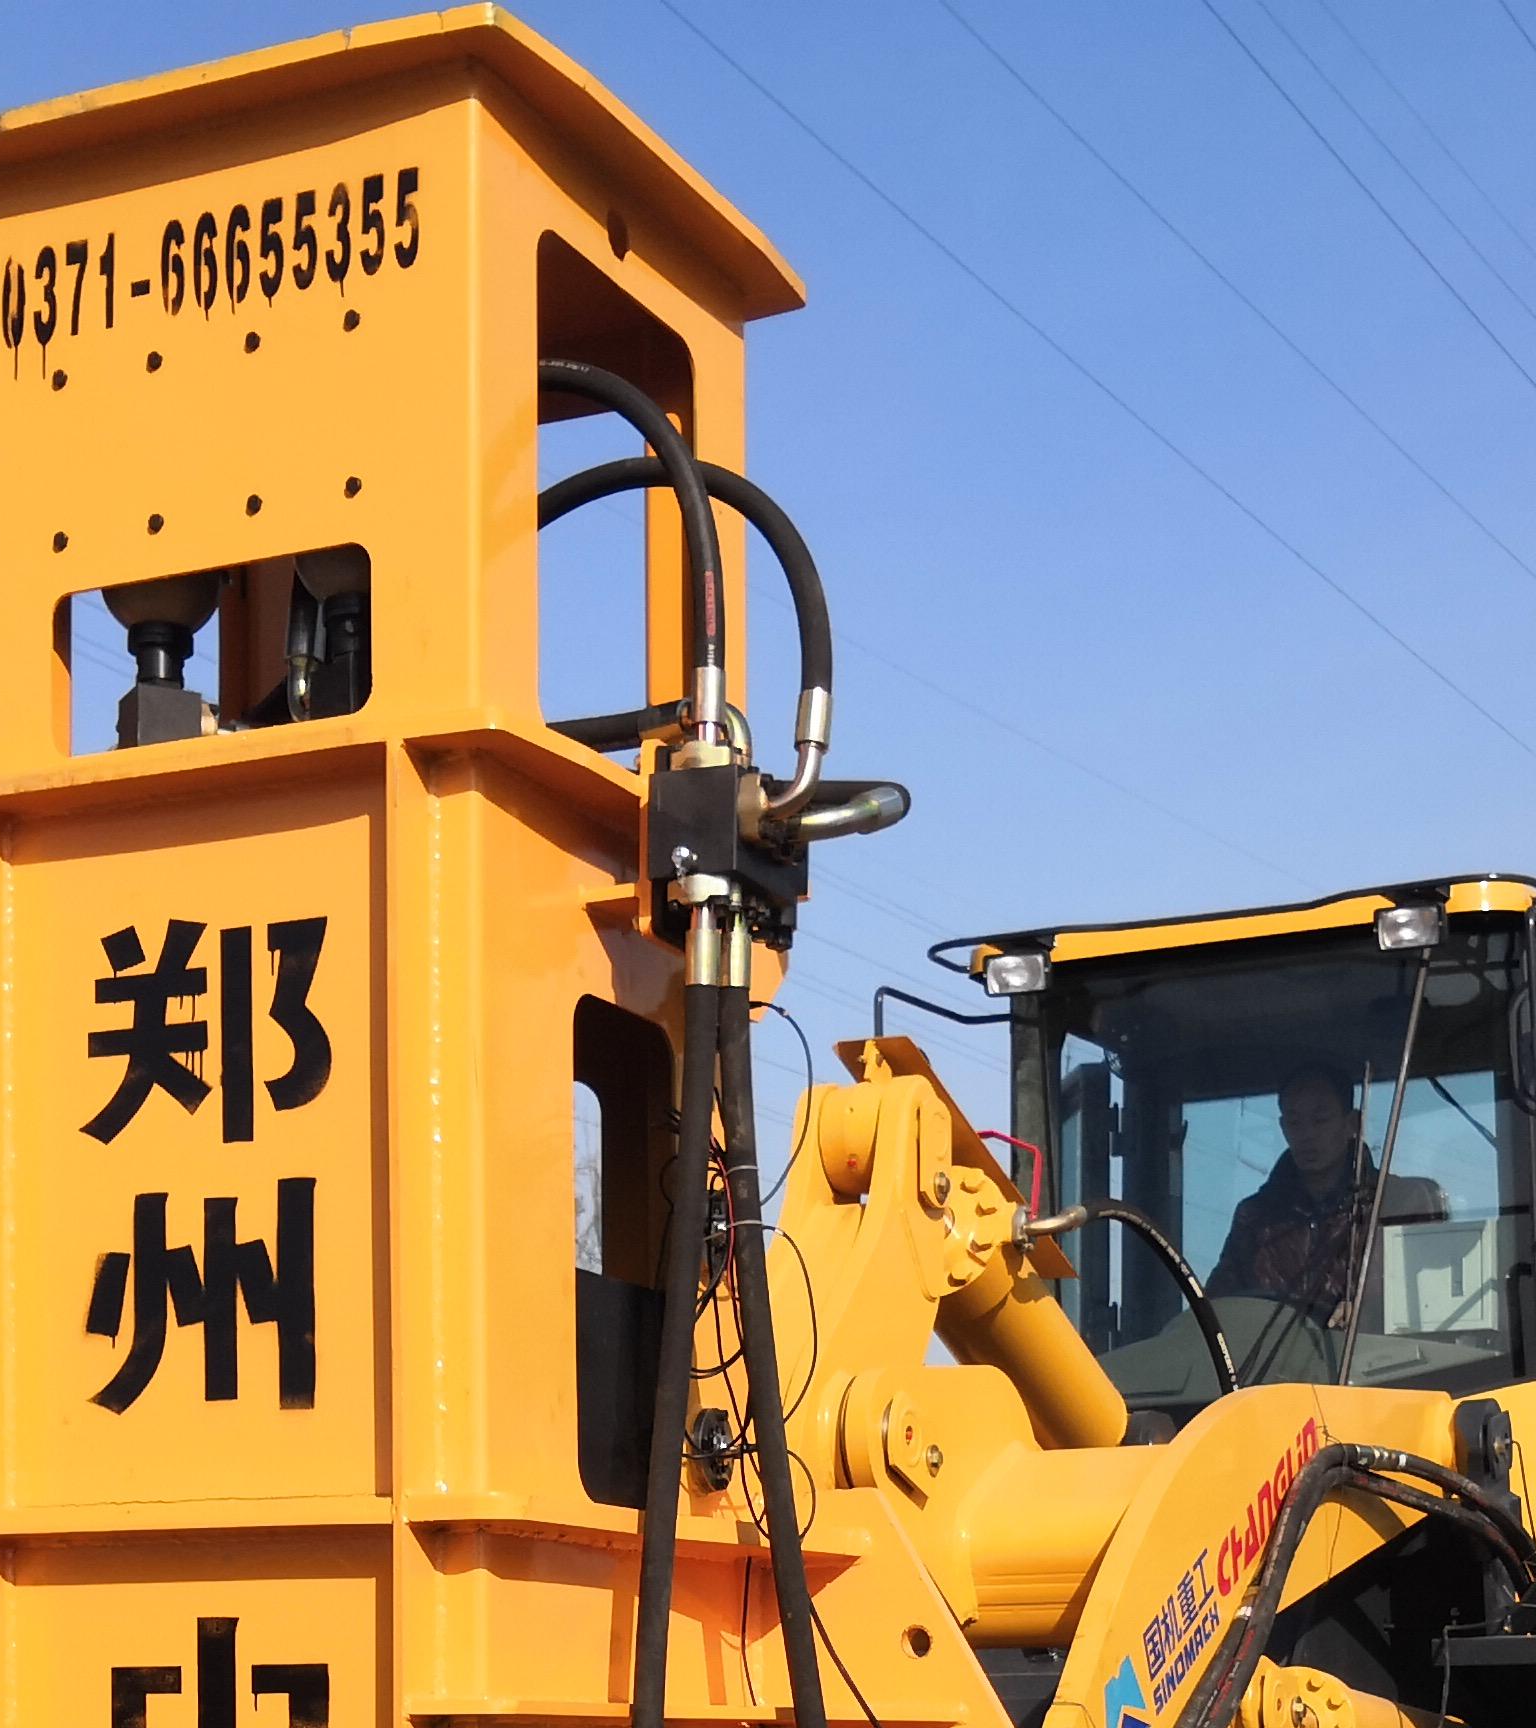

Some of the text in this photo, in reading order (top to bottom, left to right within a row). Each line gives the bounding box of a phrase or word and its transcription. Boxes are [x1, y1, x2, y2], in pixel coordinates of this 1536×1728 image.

[1, 166, 420, 350] 0371-66655355
[1142, 1547, 1214, 1682] 国机重工
[1152, 1600, 1220, 1716] SINOMACH
